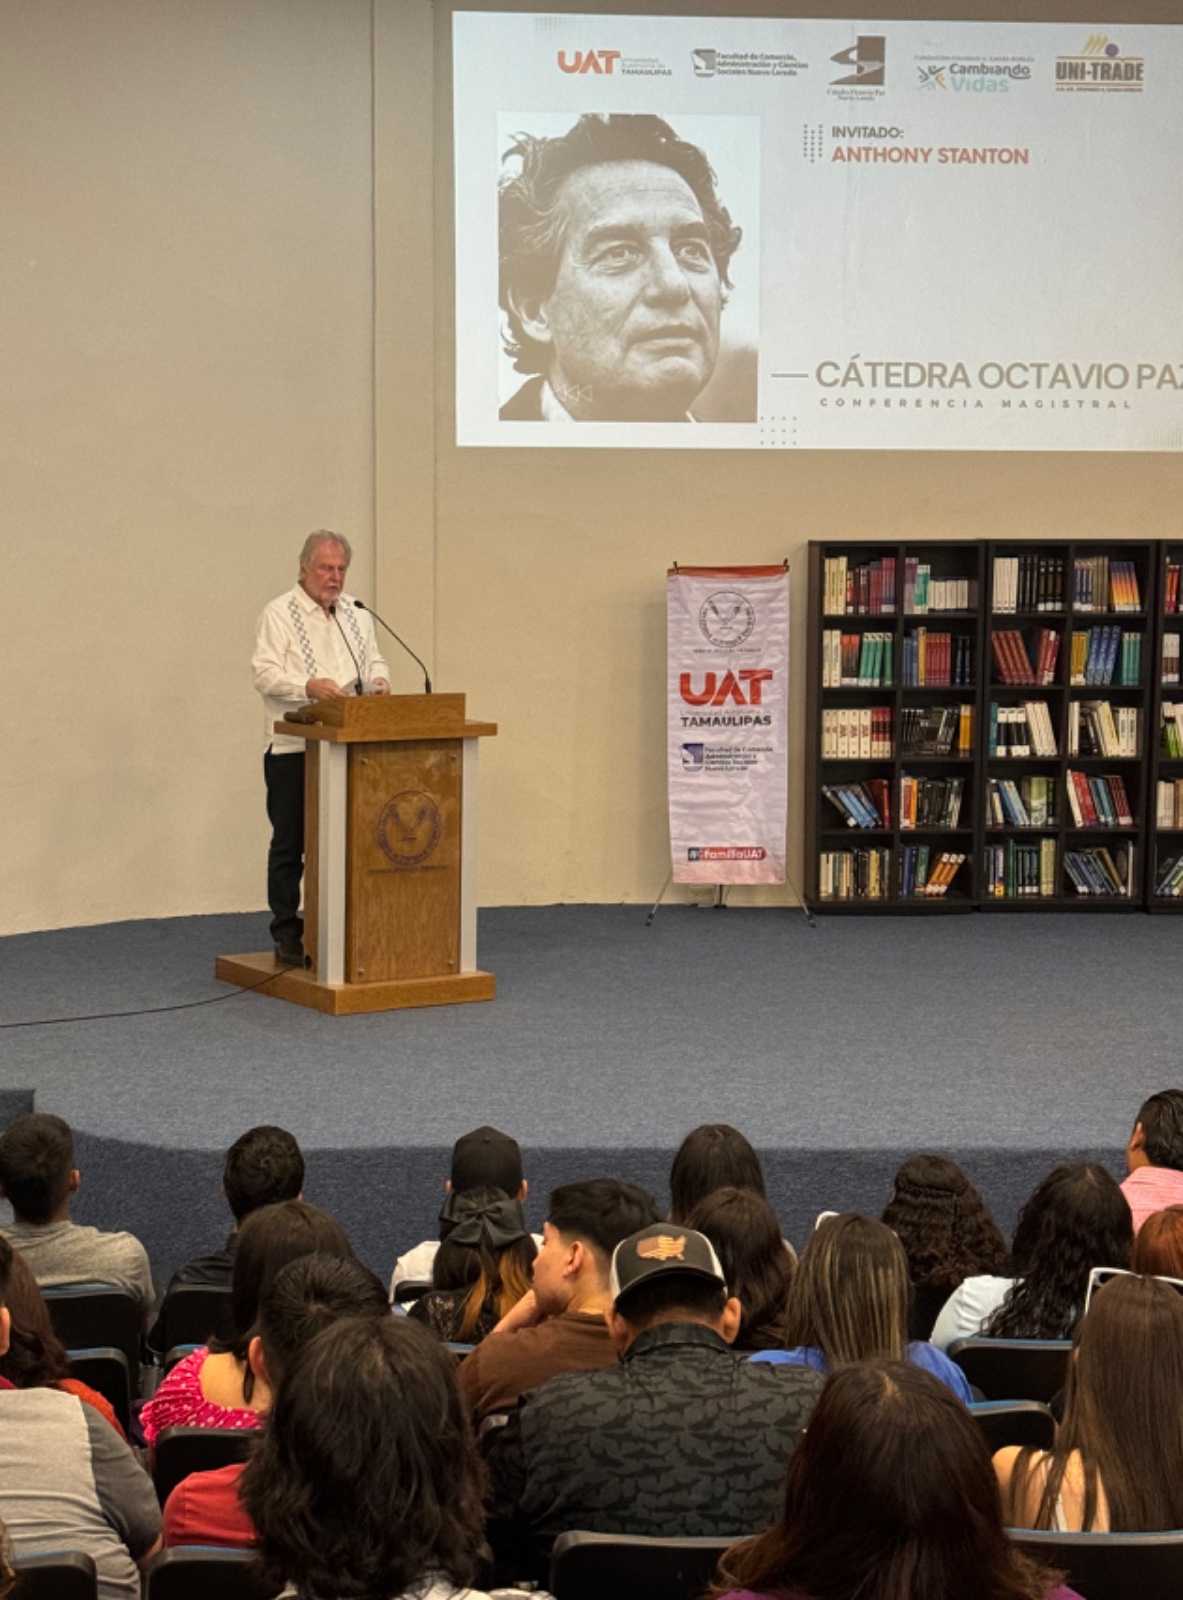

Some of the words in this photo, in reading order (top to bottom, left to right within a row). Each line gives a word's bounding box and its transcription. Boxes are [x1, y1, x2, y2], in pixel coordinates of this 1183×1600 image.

[557, 49, 620, 74] UAT
[949, 63, 1031, 80] Cambiando
[1055, 61, 1144, 81] UNI-TRADE
[950, 78, 1010, 93] Vidas
[832, 126, 905, 140] INVITADO:
[832, 147, 933, 164] ANTHONY
[938, 148, 1030, 165] STANTON
[815, 354, 972, 389] CÁTEDRA
[978, 362, 1130, 390] OCTAVIO
[820, 397, 985, 408] CONFERENCIA
[1001, 399, 1132, 409] MAGISTRAL
[680, 669, 773, 706] UAT
[680, 715, 772, 728] TAMAULIPAS
